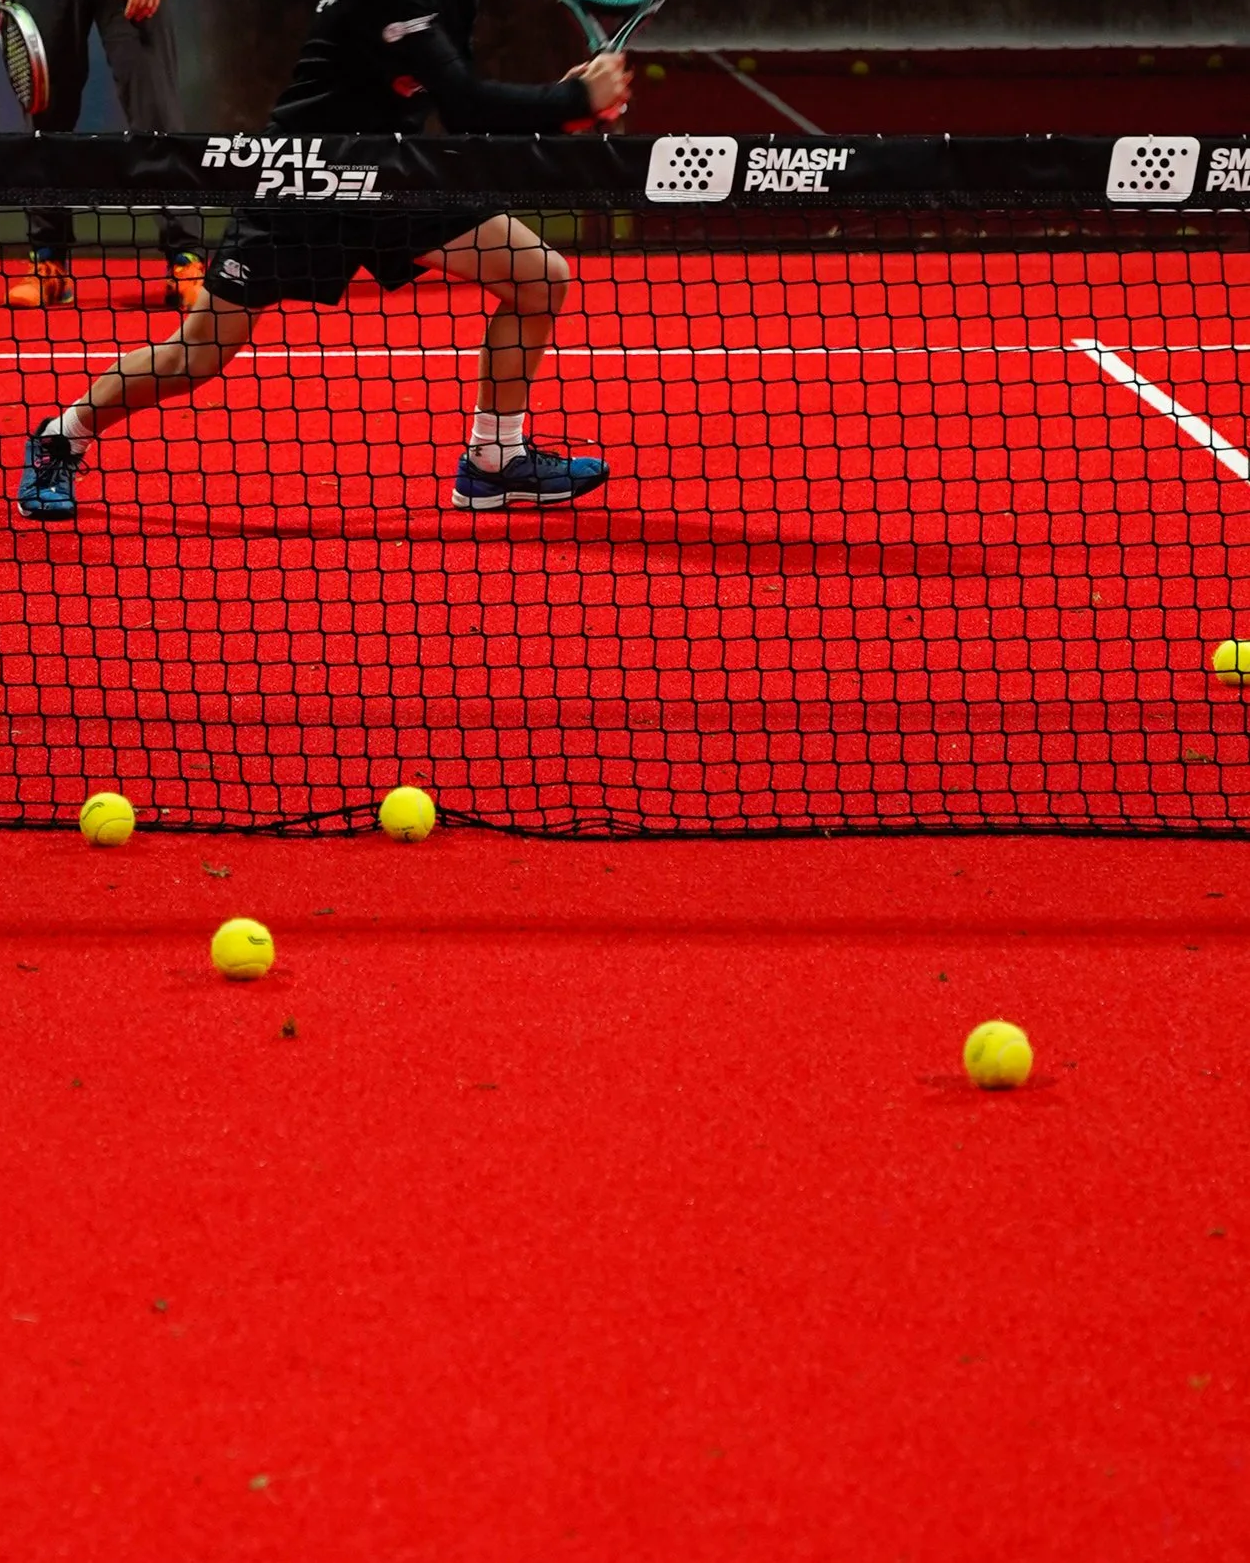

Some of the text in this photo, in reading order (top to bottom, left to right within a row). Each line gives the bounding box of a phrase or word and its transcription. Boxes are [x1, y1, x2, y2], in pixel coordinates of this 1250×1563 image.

[201, 137, 327, 168] ROYAL
[748, 147, 848, 171] SMASH
[254, 169, 382, 201] PADEL
[744, 169, 829, 193] PADEL
